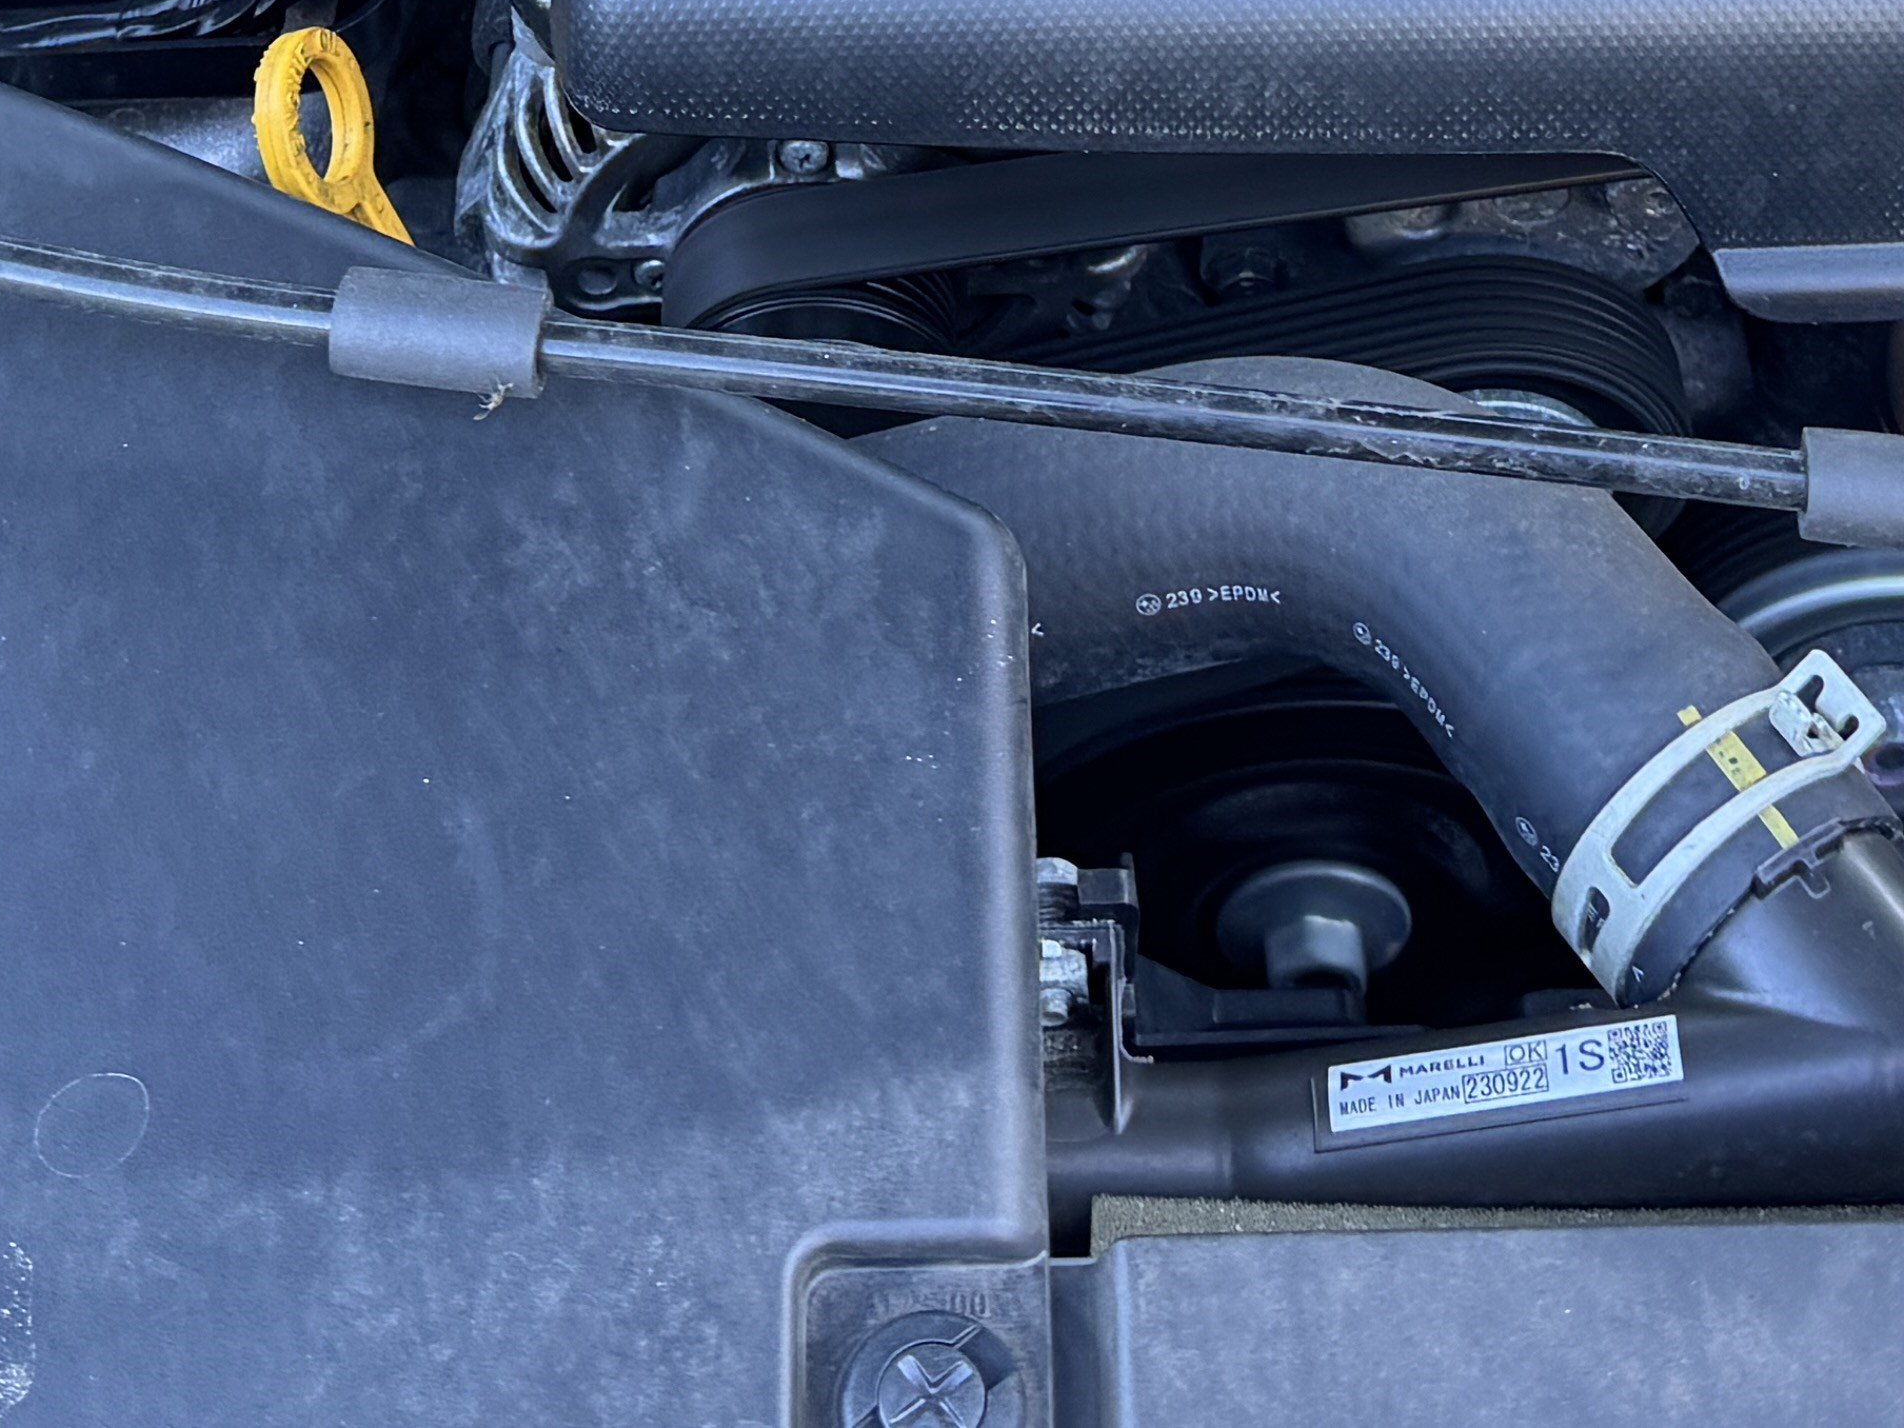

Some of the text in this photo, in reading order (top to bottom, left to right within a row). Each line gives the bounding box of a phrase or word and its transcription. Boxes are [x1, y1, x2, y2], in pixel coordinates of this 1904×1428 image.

[1398, 1054, 1486, 1080] MARELLI
[1507, 1043, 1546, 1065] OK
[1465, 1069, 1547, 1100] 230922
[1338, 1084, 1461, 1117] MADE IN JAPAN
